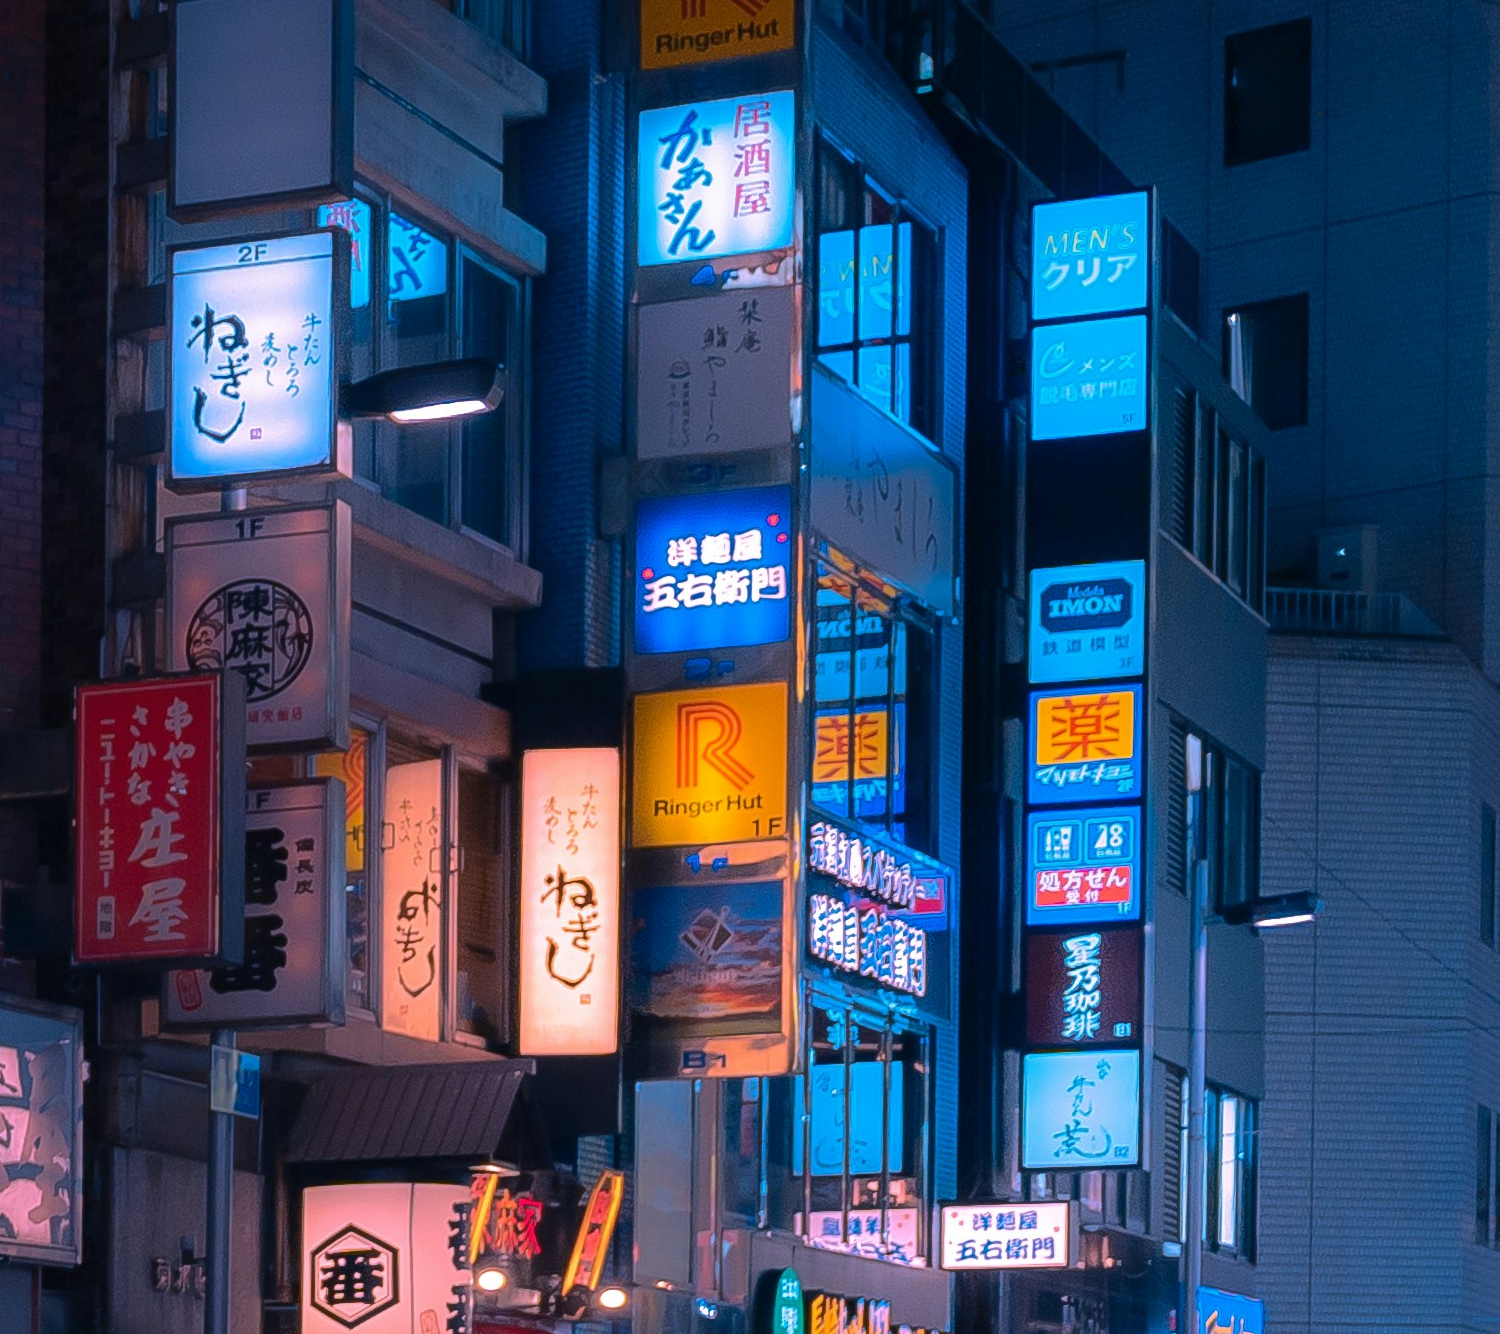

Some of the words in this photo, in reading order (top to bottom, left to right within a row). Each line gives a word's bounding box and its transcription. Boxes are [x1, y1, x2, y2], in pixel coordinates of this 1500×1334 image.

[656, 27, 733, 54] Ringer
[736, 18, 780, 41] Hut
[733, 99, 772, 219] 居酒屋
[658, 108, 716, 256] かあさん
[237, 243, 268, 264] 2F
[1043, 223, 1138, 257] MEN'S
[1042, 253, 1138, 291] クリア
[301, 312, 322, 368] 牛たん
[186, 303, 251, 445] ねぎし
[1078, 351, 1137, 374] メンズ
[234, 517, 265, 540] 1F
[642, 565, 788, 612] 五右衛門
[1048, 595, 1124, 618] IMON
[1043, 634, 1130, 657] 鉄道模型
[1051, 695, 1121, 762] 薬
[127, 704, 157, 806] さかな
[163, 696, 196, 808] 串やき
[581, 782, 600, 829] 牛たん
[654, 797, 723, 818] Ringer
[726, 794, 763, 810] Hut
[751, 817, 783, 837] 1F
[127, 807, 189, 943] 庄屋
[1039, 869, 1128, 893] 処方せん
[540, 863, 602, 990] ねぎし
[1061, 932, 1103, 1041] 星乃珈琲
[954, 1236, 1056, 1264] 五右衛門
